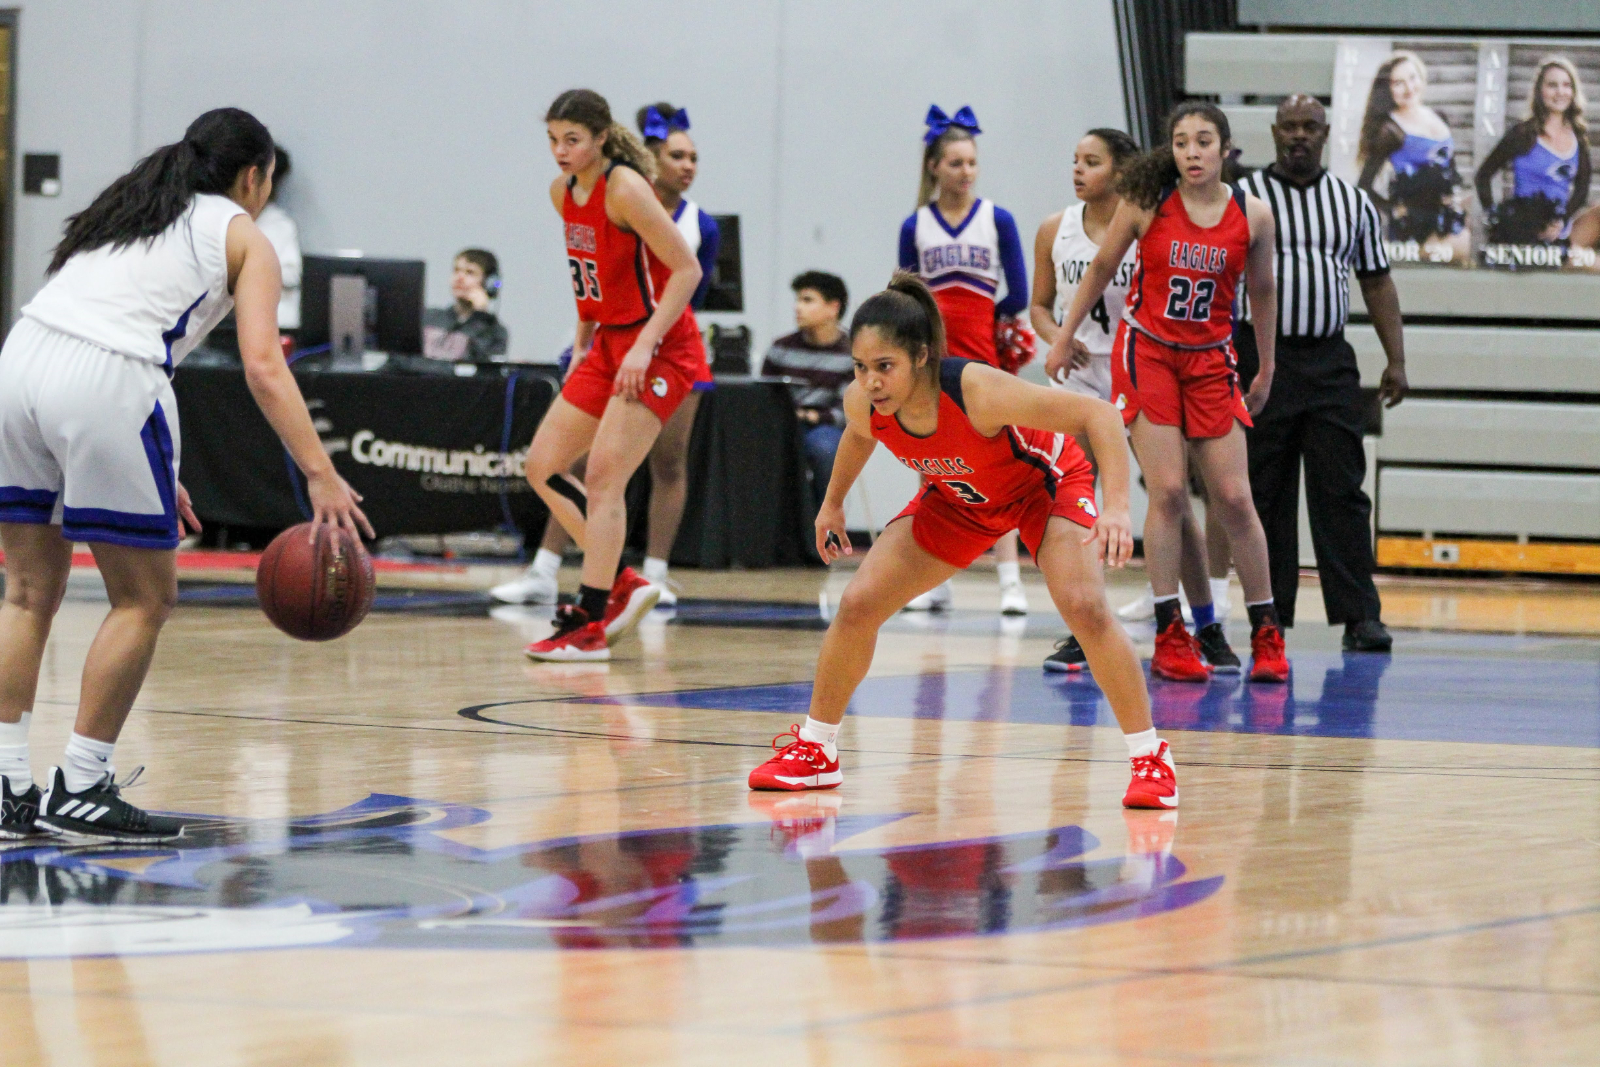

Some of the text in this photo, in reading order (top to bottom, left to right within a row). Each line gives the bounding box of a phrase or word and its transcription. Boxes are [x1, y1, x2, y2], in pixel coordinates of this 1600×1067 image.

[923, 244, 992, 273] EAGLES
[1169, 240, 1228, 274] EAGLES
[1485, 244, 1562, 267] SENIOR
[567, 255, 604, 302] 35
[1164, 275, 1216, 322] 22
[351, 429, 529, 478] Communicat
[941, 479, 989, 505] 3
